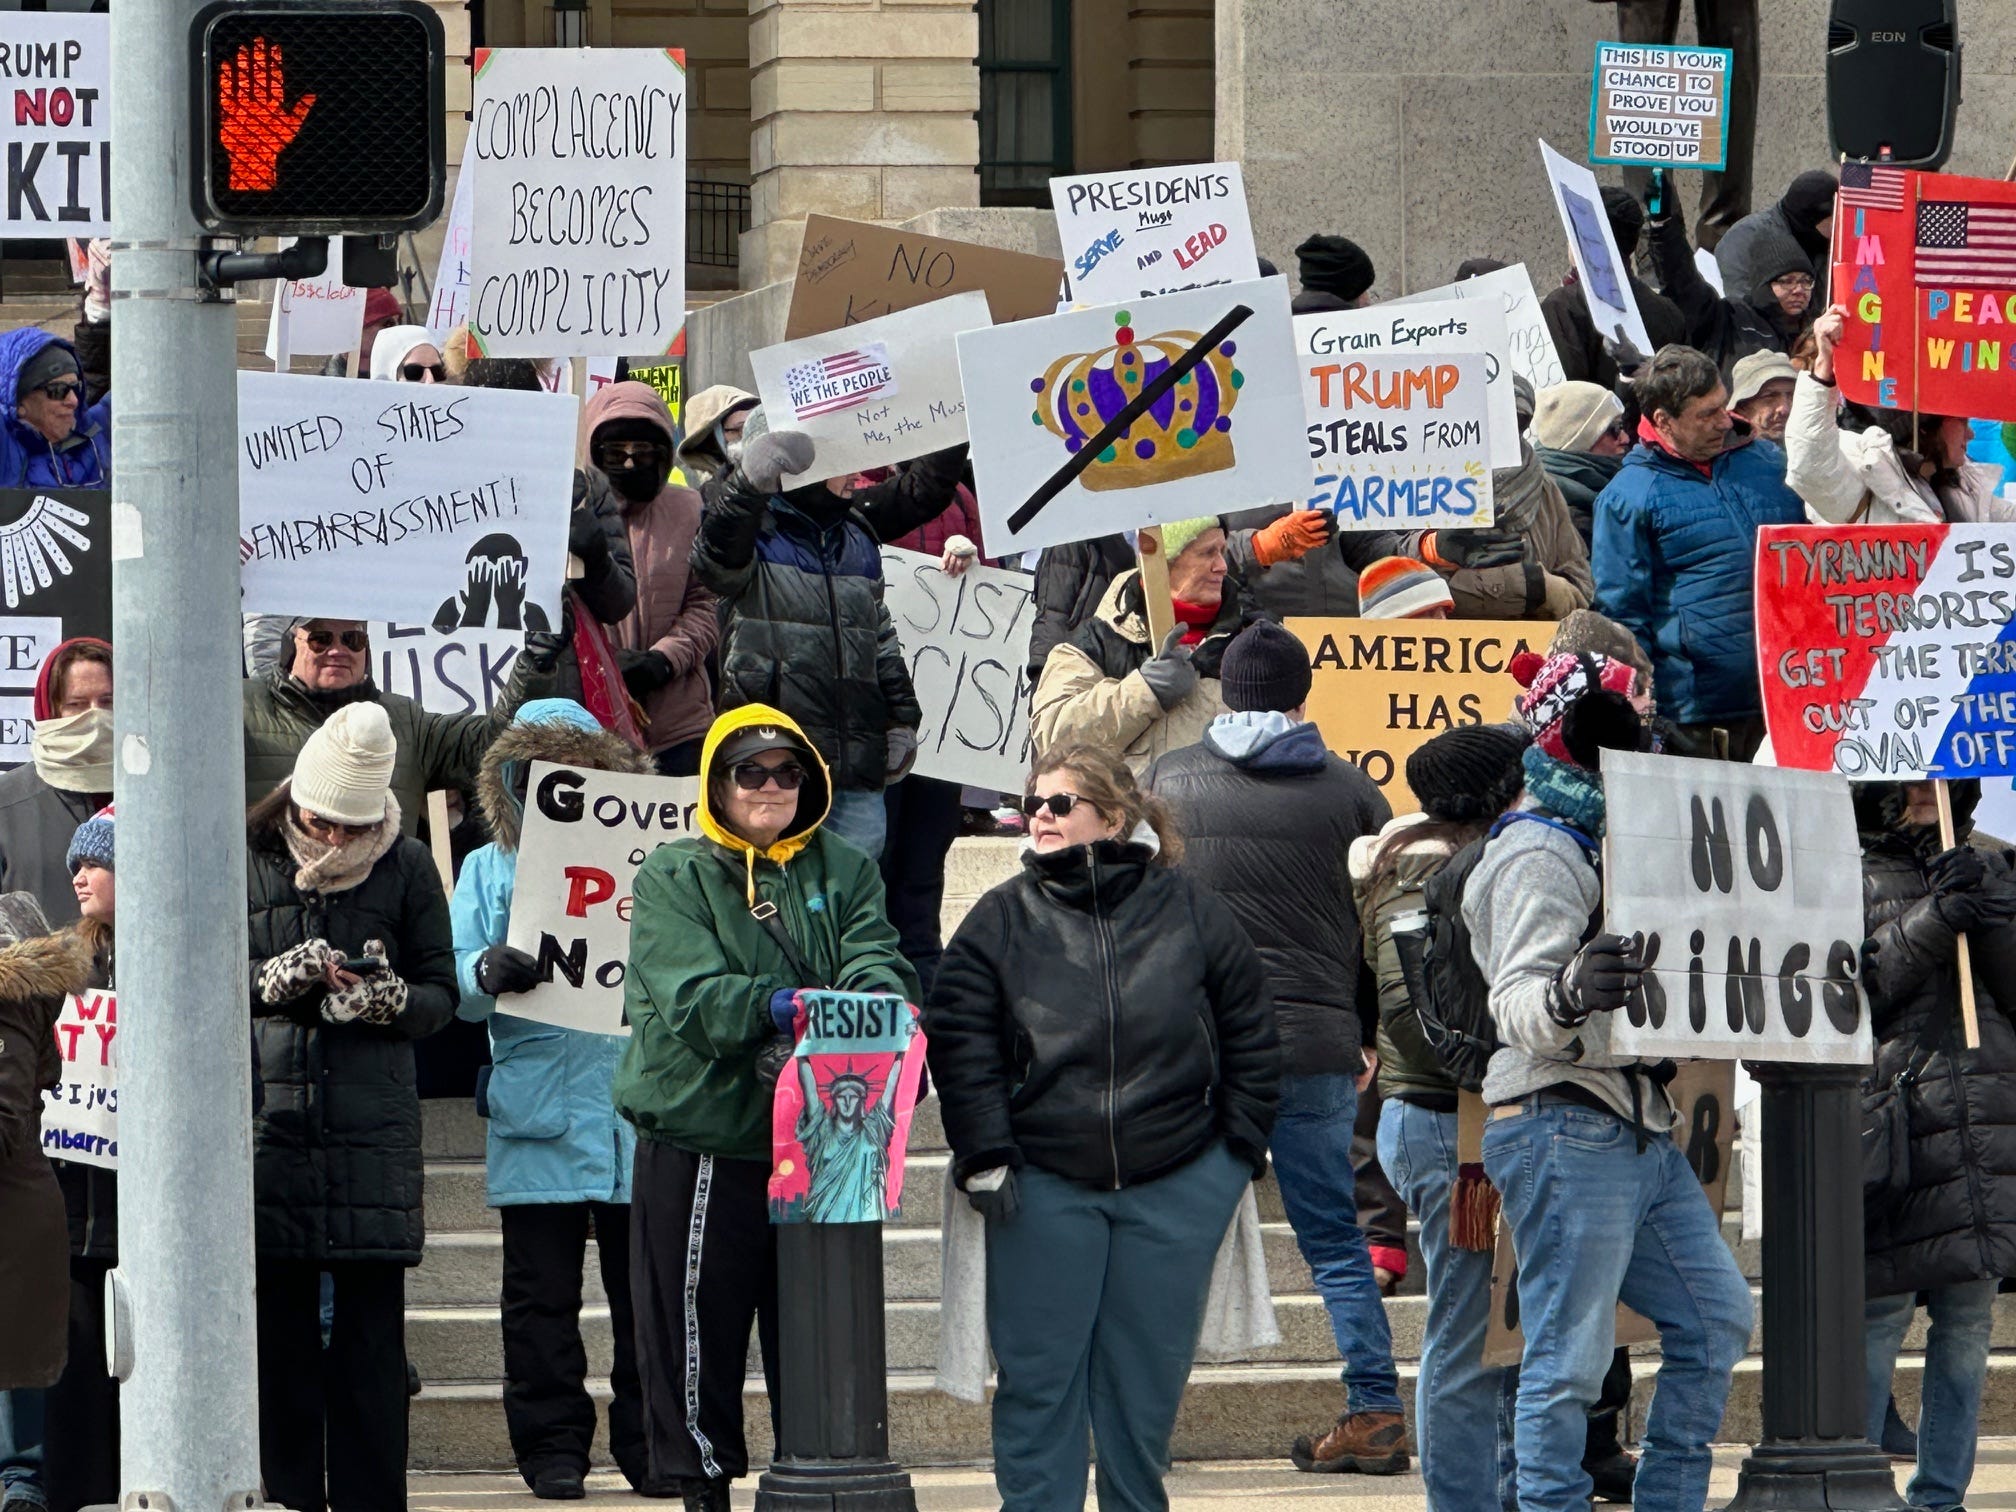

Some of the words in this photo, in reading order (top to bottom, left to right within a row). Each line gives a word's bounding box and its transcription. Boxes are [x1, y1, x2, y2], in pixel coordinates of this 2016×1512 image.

[1872, 31, 1906, 42] EON
[1604, 48, 1640, 64] THIS
[1651, 51, 1665, 65] IS
[1678, 53, 1723, 69] YOUR
[1608, 72, 1677, 89] CHANCE
[1689, 77, 1711, 90] TO
[15, 87, 98, 126] NOT
[477, 85, 681, 159] COMPLACENCY
[1613, 94, 1667, 110] PROVE
[1679, 98, 1713, 112] YOU
[1610, 119, 1699, 137] WOULD'VE
[1613, 141, 1670, 157] STOOD
[1676, 144, 1698, 157] UP
[510, 182, 652, 247] BECOMES
[1067, 174, 1229, 215] PRESIDENTS
[888, 244, 954, 288] NO
[1074, 228, 1124, 281] SERVE
[1137, 250, 1162, 270] AND
[1173, 223, 1227, 270] LEAD
[477, 267, 670, 337] COMPLICITY
[1310, 327, 1381, 354] Grain
[1391, 318, 1467, 346] Exports
[791, 388, 812, 407] WE
[814, 381, 840, 400] THE
[843, 367, 892, 393] PEOPLE
[1310, 362, 1459, 410] TRUMP
[246, 416, 343, 469] UNITED
[377, 397, 469, 442] STATES
[857, 405, 891, 426] Not
[894, 417, 923, 435] the
[1307, 419, 1408, 458] STEALS
[1423, 420, 1480, 453] FROM
[351, 453, 393, 494] OF
[1307, 474, 1478, 521] FARMERS
[1769, 538, 1928, 588] TYRANNY
[1955, 540, 2015, 583] IS
[1778, 647, 1849, 688] GET
[1869, 643, 1942, 681] THE
[1386, 693, 1482, 730] HAS
[1803, 698, 1877, 734] OUT
[1894, 695, 1939, 730] OF
[1951, 691, 2016, 726] THE
[1834, 732, 1944, 777] OVAL
[1951, 730, 2015, 767] OFF
[1691, 793, 1783, 893] NO
[804, 997, 902, 1039] RESIST
[69, 1084, 81, 1104] I
